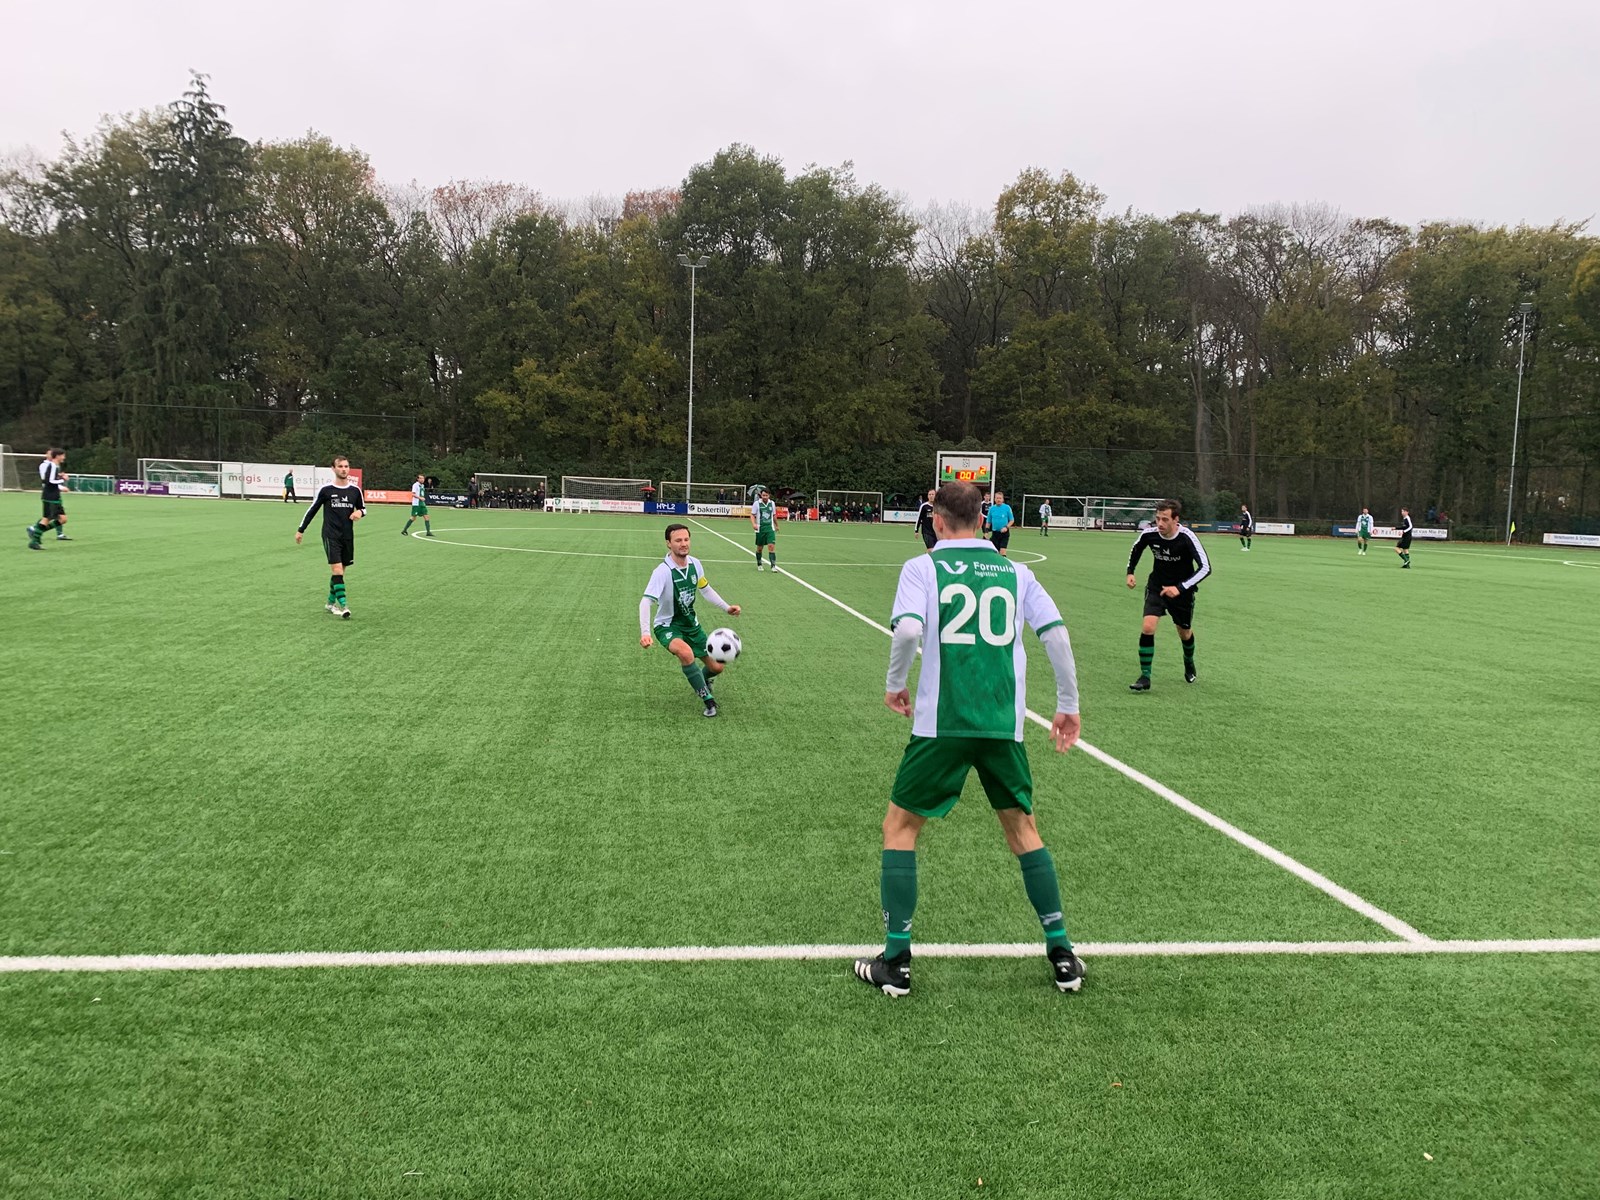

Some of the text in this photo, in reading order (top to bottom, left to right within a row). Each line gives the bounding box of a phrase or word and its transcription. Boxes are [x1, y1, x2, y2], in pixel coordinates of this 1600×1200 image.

[228, 473, 262, 484] magis
[366, 491, 386, 499] ZUS
[973, 561, 1015, 574] Formule
[939, 583, 1016, 647] 20
